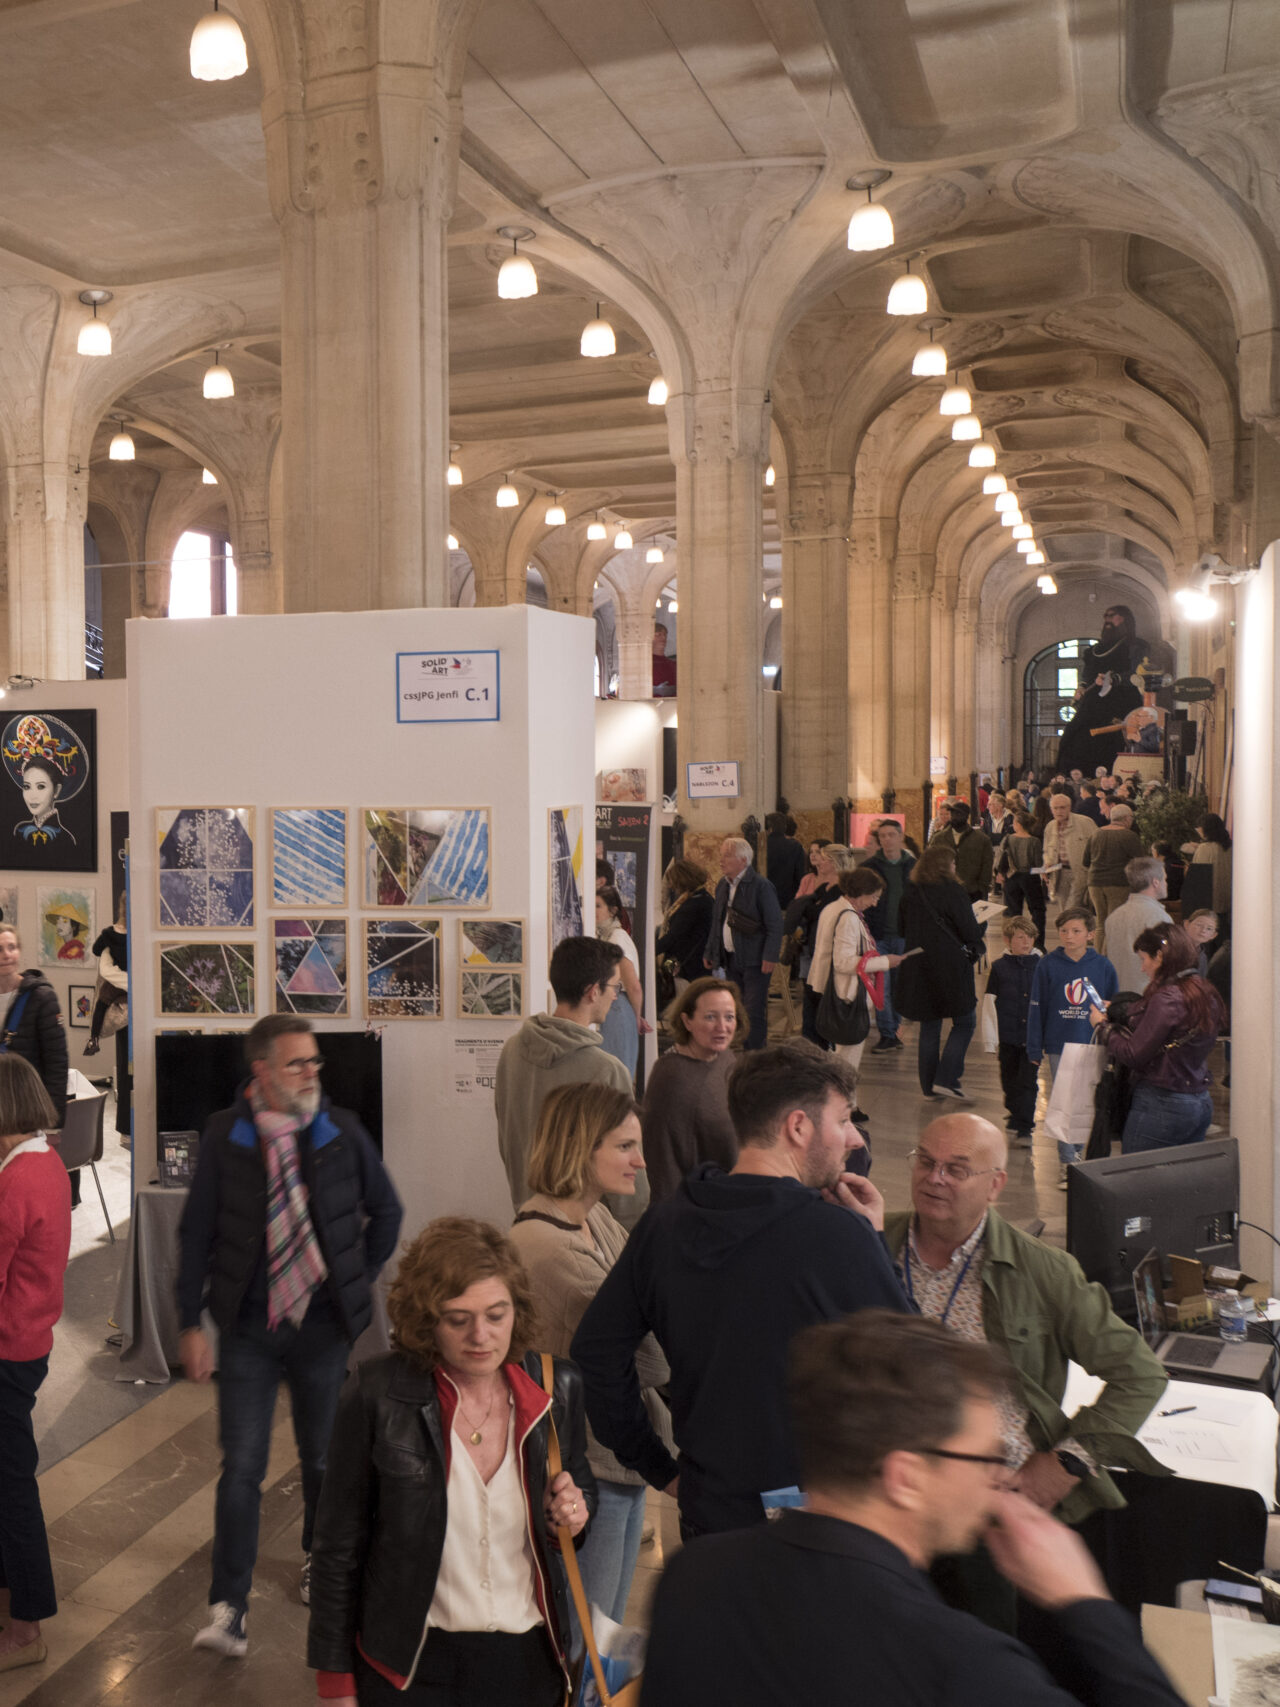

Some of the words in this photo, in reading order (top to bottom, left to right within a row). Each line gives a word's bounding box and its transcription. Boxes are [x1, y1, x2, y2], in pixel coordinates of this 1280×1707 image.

[432, 667, 448, 675] ART
[465, 687, 489, 701] C.1
[721, 779, 735, 787] C.4
[596, 807, 612, 820] ART
[643, 814, 649, 827] 2
